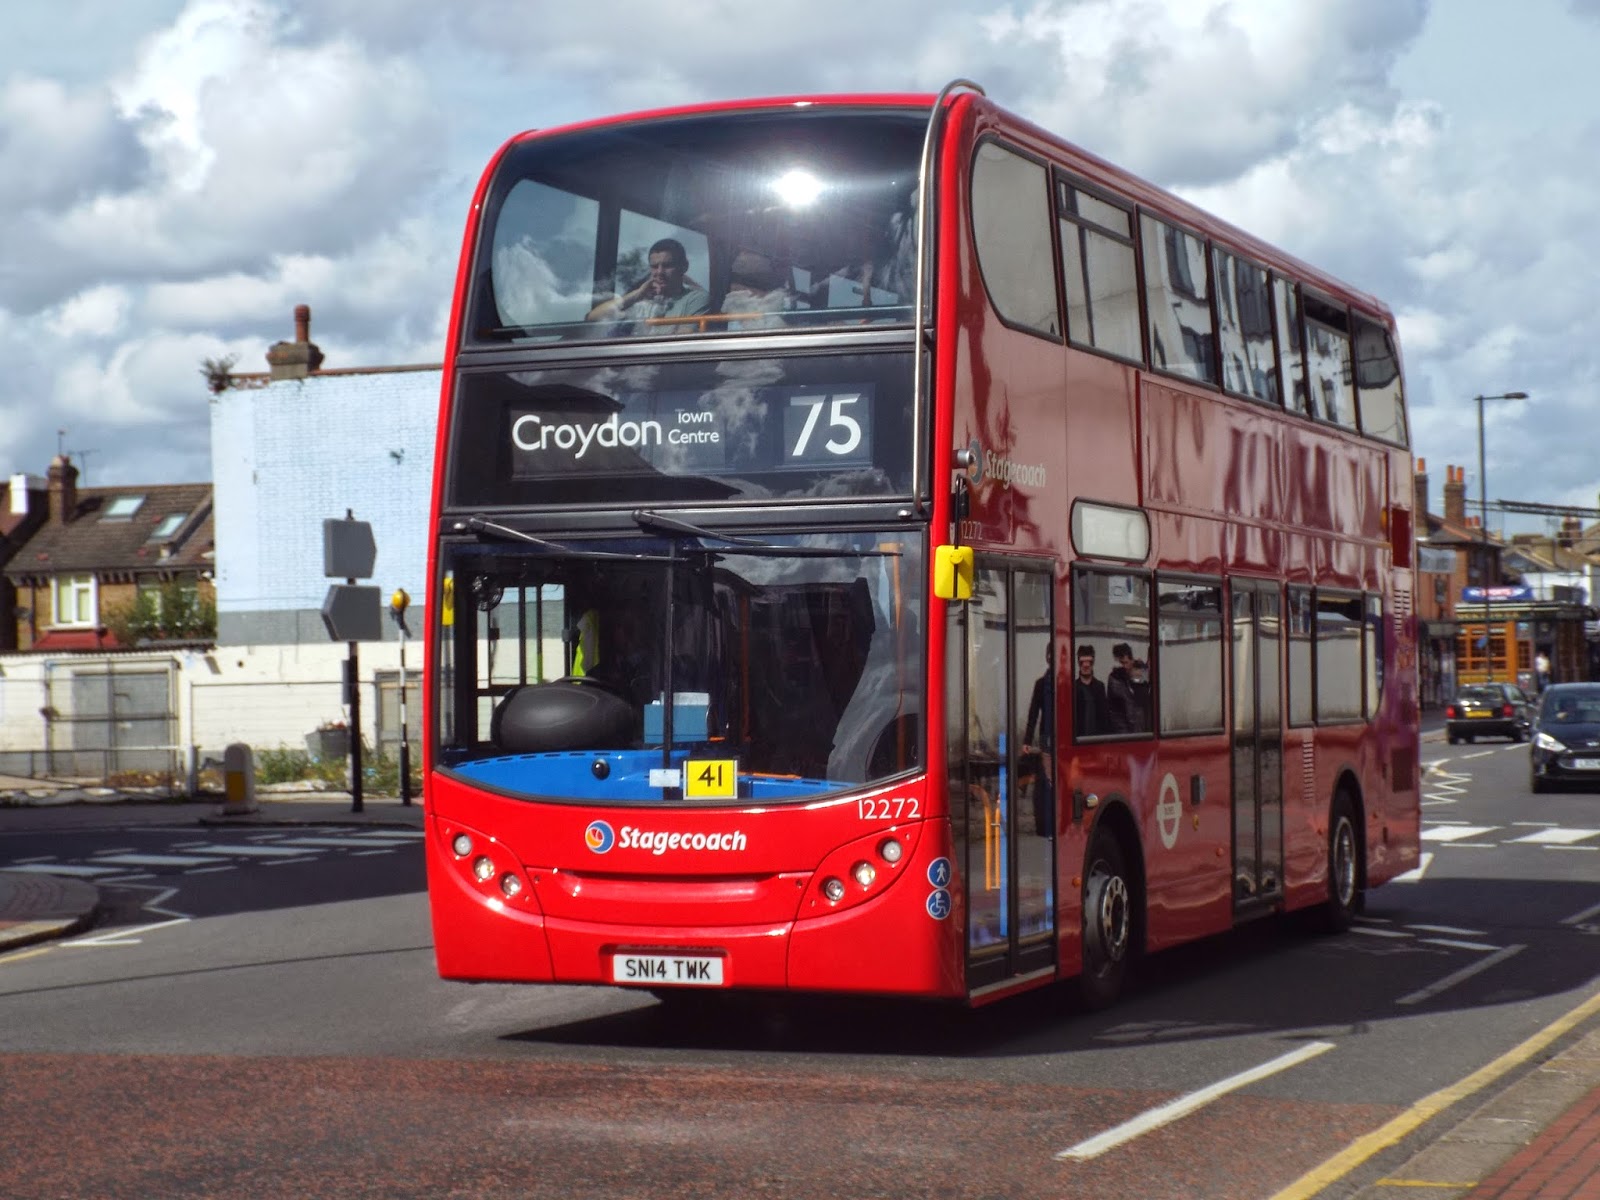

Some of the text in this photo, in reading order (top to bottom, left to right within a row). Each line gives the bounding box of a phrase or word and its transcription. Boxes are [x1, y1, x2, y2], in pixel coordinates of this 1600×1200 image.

[674, 408, 714, 425] Town
[789, 392, 862, 457] 75
[511, 411, 663, 460] Croydon
[667, 428, 721, 445] Centre
[985, 449, 1046, 490] Stagecoach
[961, 520, 983, 540] 12272
[697, 764, 723, 788] 41
[858, 797, 921, 820] 12272
[618, 825, 748, 856] Stagecoach
[625, 958, 711, 981] SN14 TWK
